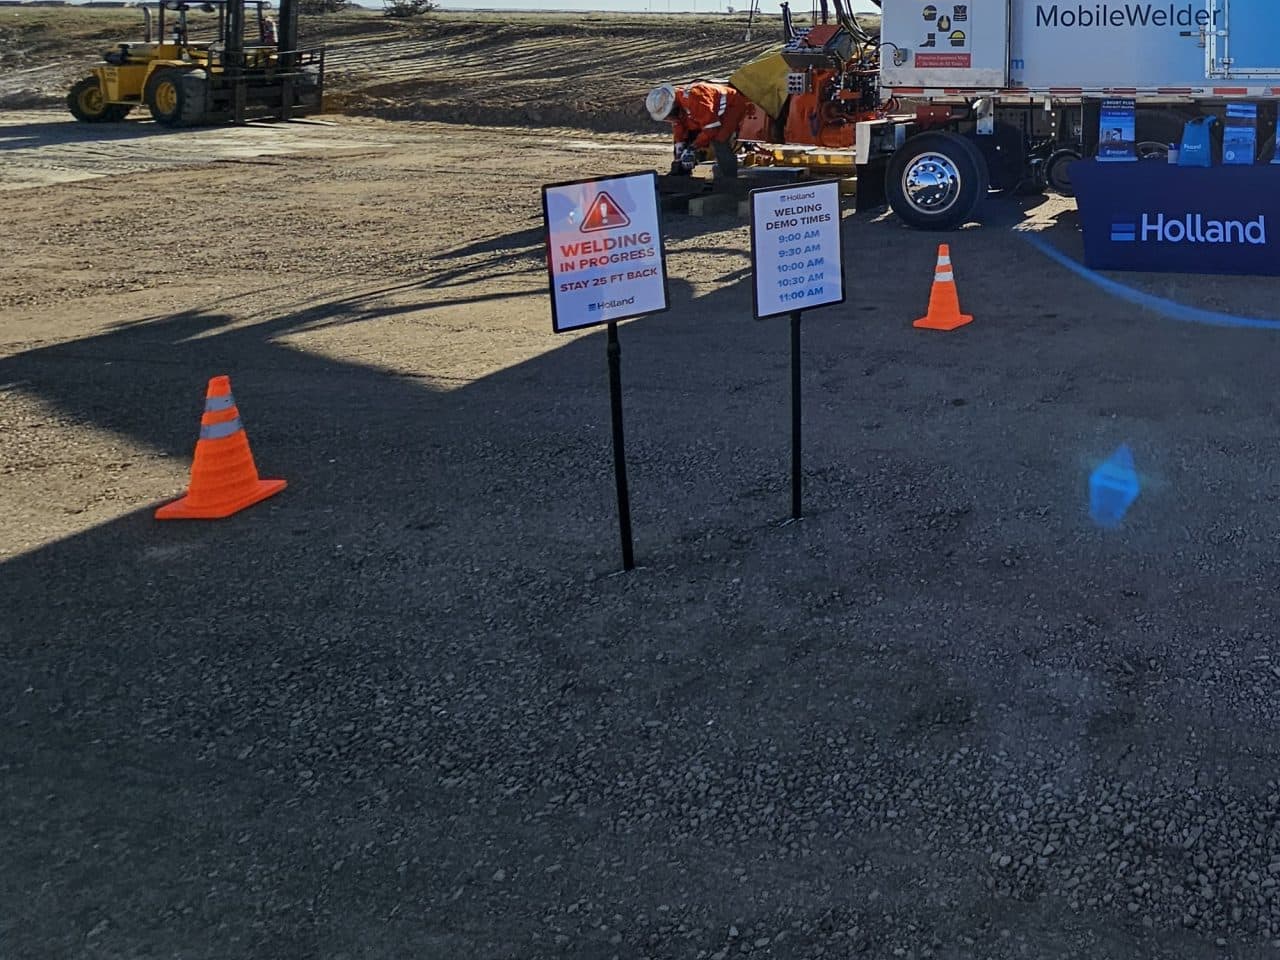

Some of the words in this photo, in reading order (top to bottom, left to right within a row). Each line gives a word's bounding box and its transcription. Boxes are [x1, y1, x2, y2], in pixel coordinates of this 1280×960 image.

[1036, 4, 1222, 27] MobileWelder
[786, 192, 815, 201] Holland
[774, 203, 822, 217] WELDING
[766, 218, 798, 231] DEMO
[800, 213, 831, 225] TIMES
[1141, 213, 1266, 244] Holland
[778, 232, 801, 243] 9:00
[804, 229, 820, 239] AM
[560, 232, 652, 257] WELDING
[778, 247, 802, 258] 9:30
[804, 244, 821, 253] AM
[560, 261, 576, 272] IN
[579, 247, 655, 269] PROGRESS
[777, 261, 804, 272] 10:00
[806, 257, 824, 268] AM
[560, 279, 589, 292] STAY
[592, 277, 607, 287] 25
[610, 273, 624, 283] FT
[627, 267, 658, 280] BACK
[777, 276, 804, 287] 10:30
[807, 272, 824, 283] AM
[779, 290, 804, 302] 11:00
[806, 286, 823, 296] AM
[597, 296, 635, 310] Holland
